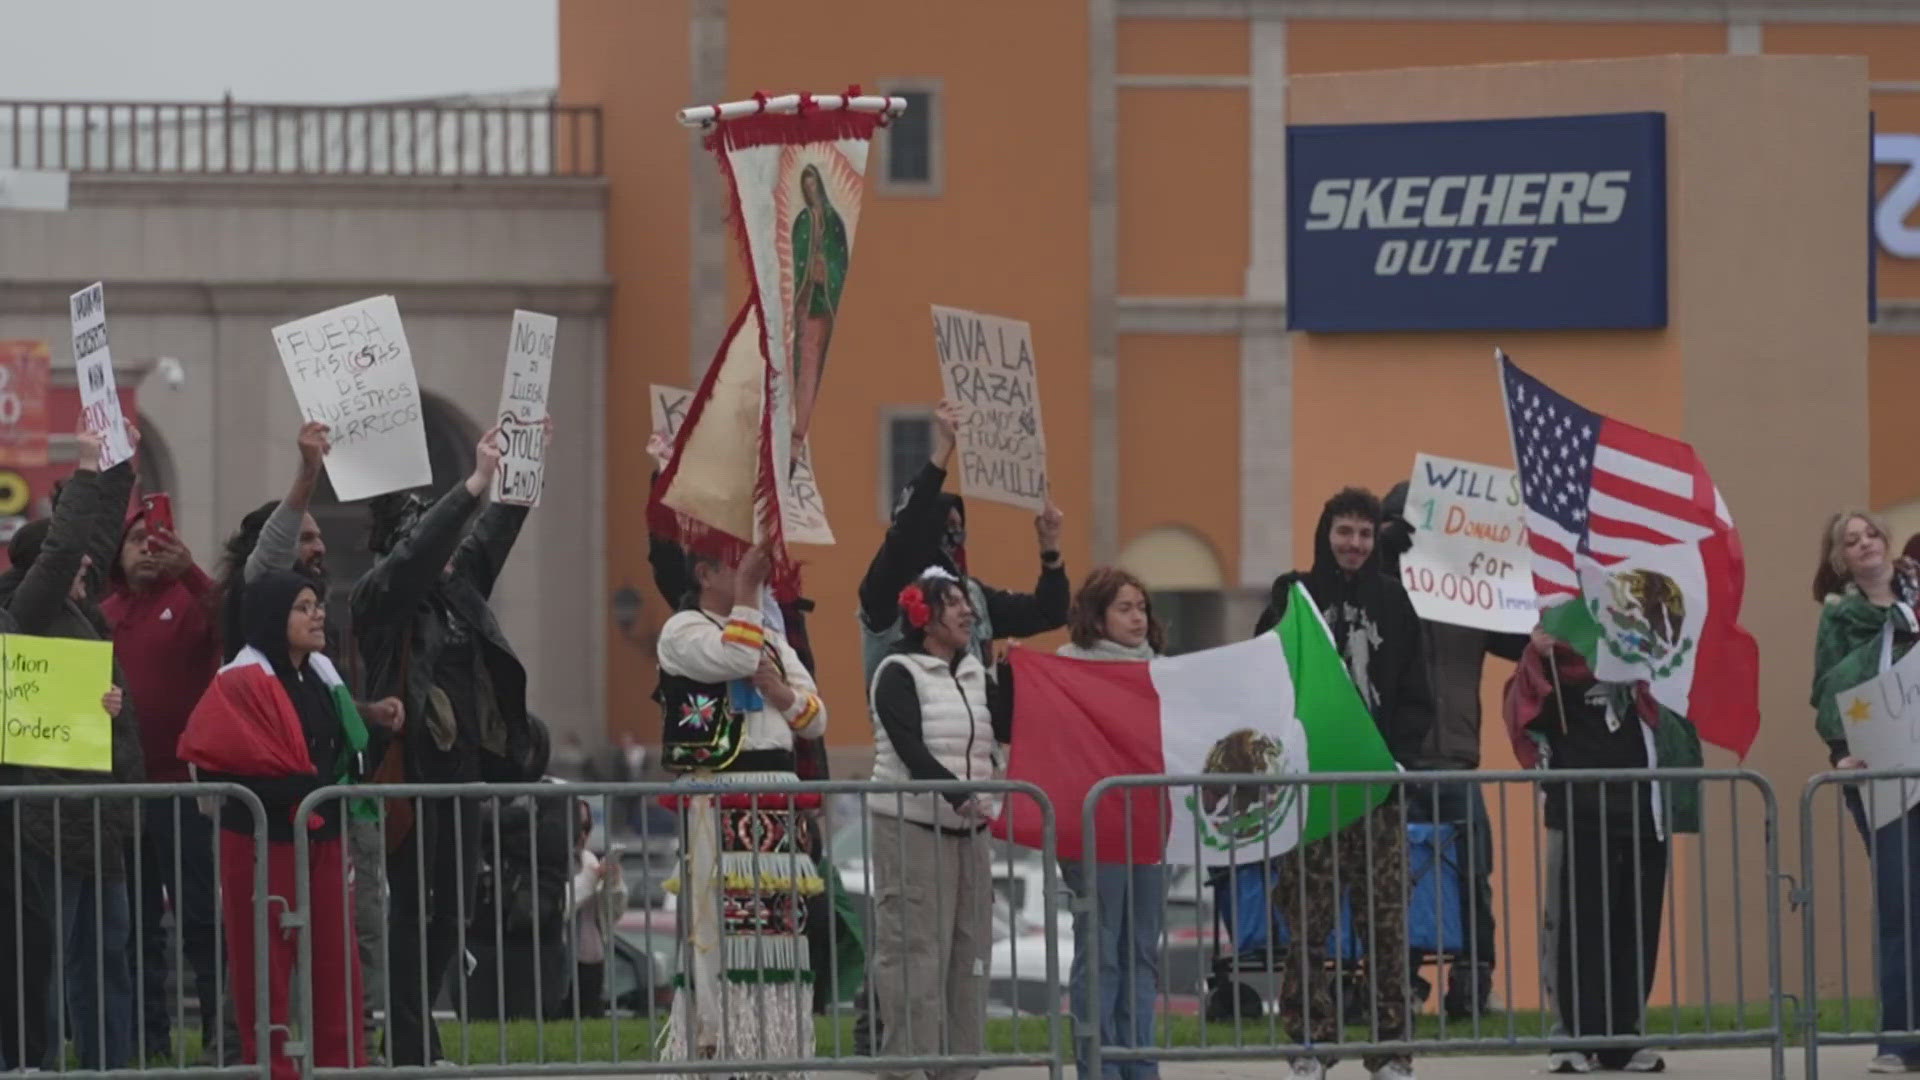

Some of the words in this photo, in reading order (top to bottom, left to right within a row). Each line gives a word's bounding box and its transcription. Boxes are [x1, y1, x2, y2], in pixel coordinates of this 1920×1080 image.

[1305, 171, 1631, 230] SKECHERS
[1374, 237, 1558, 275] OUTLET
[287, 310, 386, 355] FUERA
[515, 322, 537, 355] NO
[934, 316, 992, 366] VIVA
[998, 326, 1034, 377] LA
[307, 383, 412, 424] NUESTROS
[336, 373, 366, 395] DE
[330, 403, 418, 445] ARRIOS
[502, 463, 537, 499] LAND
[962, 452, 1046, 499] FAMILIA
[1425, 461, 1497, 503] WILL
[1420, 497, 1437, 531] 1
[1444, 505, 1511, 543] DONALD
[1468, 552, 1513, 580] for
[8, 717, 71, 742] Orders
